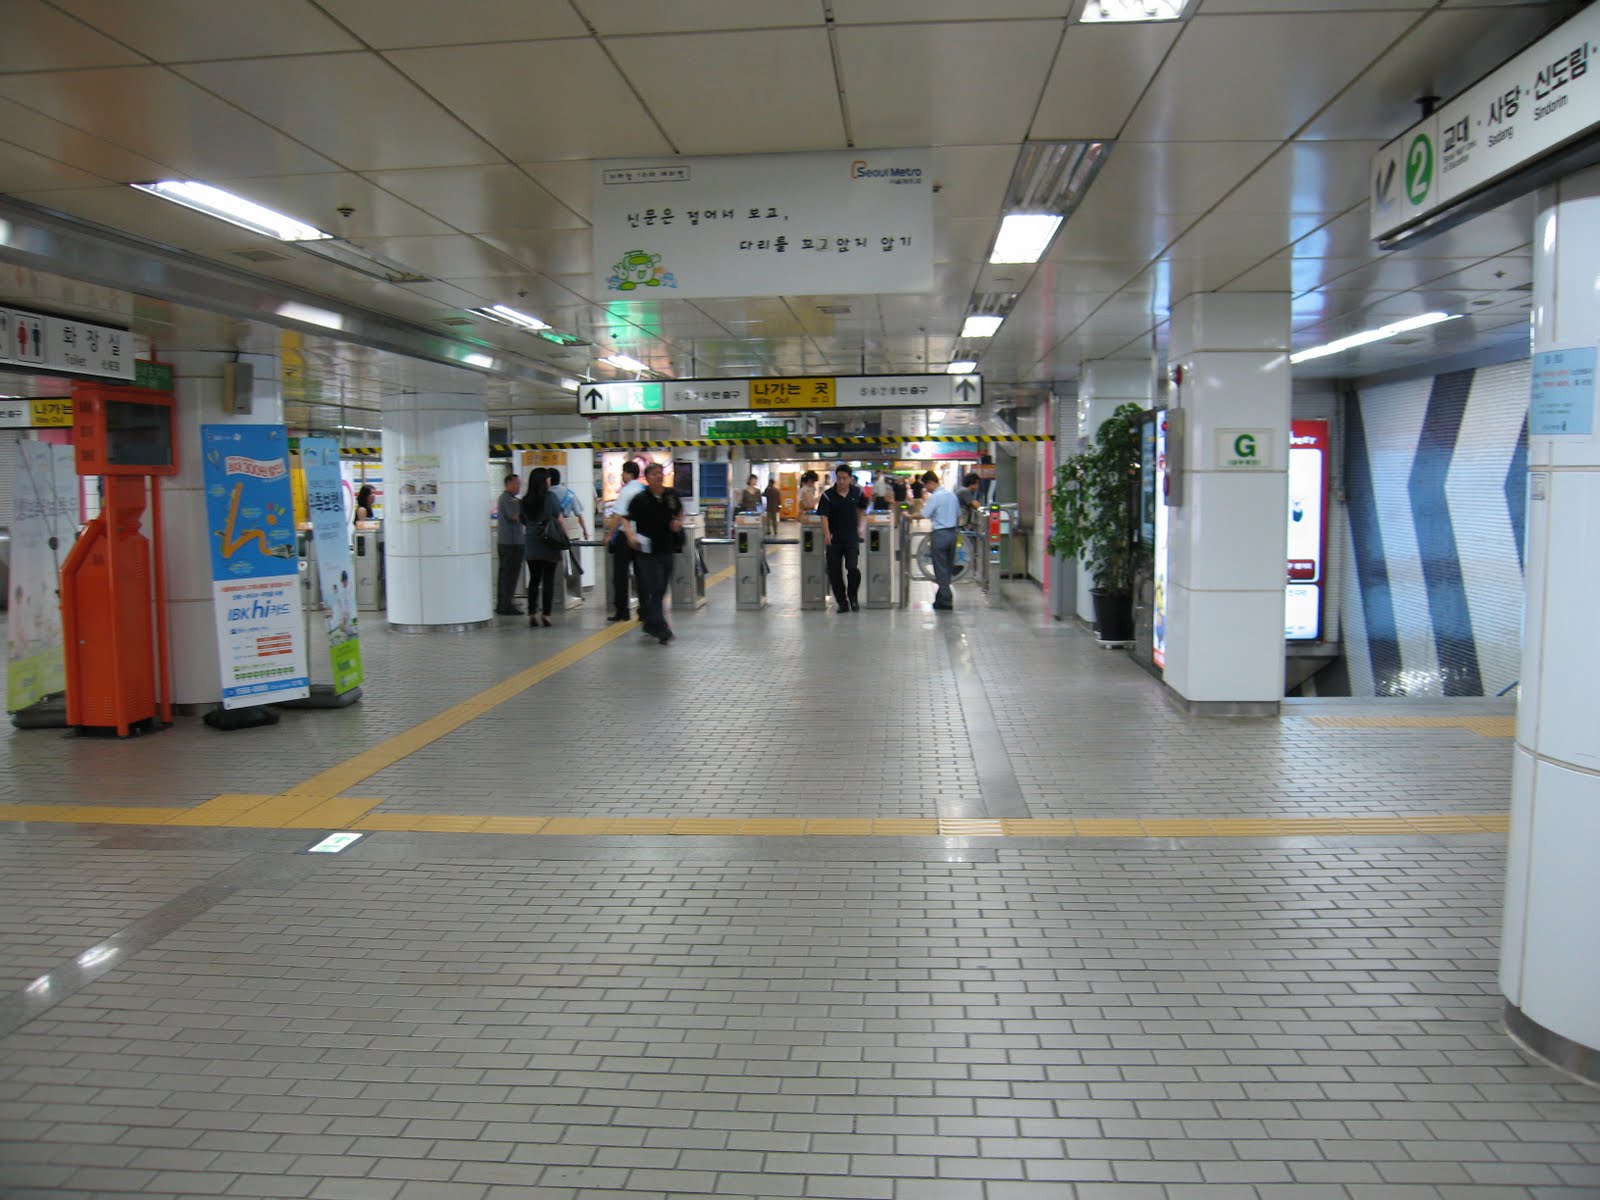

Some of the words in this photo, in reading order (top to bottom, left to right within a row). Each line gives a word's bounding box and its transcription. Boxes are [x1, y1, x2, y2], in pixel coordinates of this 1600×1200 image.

[1443, 114, 1471, 153] 교대
[1488, 85, 1520, 126] 사당
[1534, 41, 1590, 101] 신도림
[1533, 94, 1569, 121] Sindorim
[1488, 125, 1514, 148] Sadang
[856, 166, 889, 178] Seoul
[890, 167, 922, 177] Metro
[1408, 136, 1429, 200] 2
[627, 207, 675, 228] 신문은
[687, 208, 736, 226] 접어서
[748, 207, 789, 221] 보고,
[739, 235, 789, 253] 다리를
[63, 325, 121, 357] 화장실
[754, 382, 801, 395] 나가는
[815, 381, 829, 395] 곳
[34, 403, 73, 415] 나가는
[755, 397, 772, 405] Way
[775, 396, 790, 404] Out
[1234, 434, 1256, 458] G
[227, 607, 251, 621] IBK
